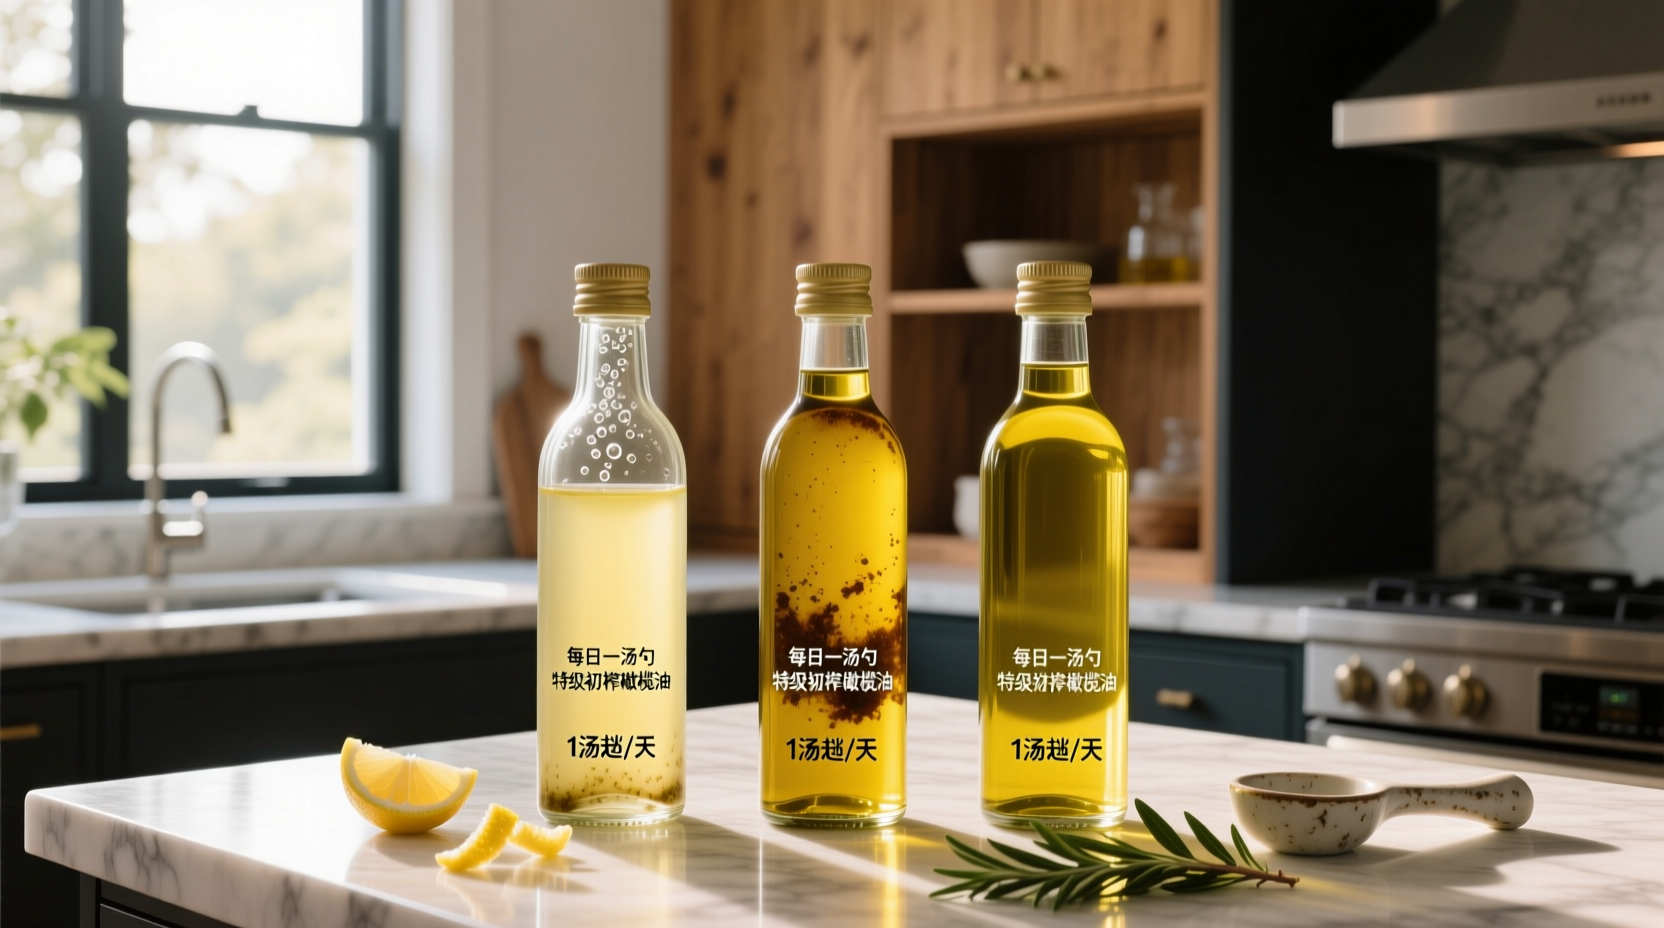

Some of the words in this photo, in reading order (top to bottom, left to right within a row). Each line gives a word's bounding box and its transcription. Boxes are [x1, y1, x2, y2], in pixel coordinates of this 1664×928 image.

[567, 646, 655, 666] 每日一汤勺
[788, 646, 877, 667] 每日一汤勺
[1012, 646, 1101, 668] 每日一汤勺
